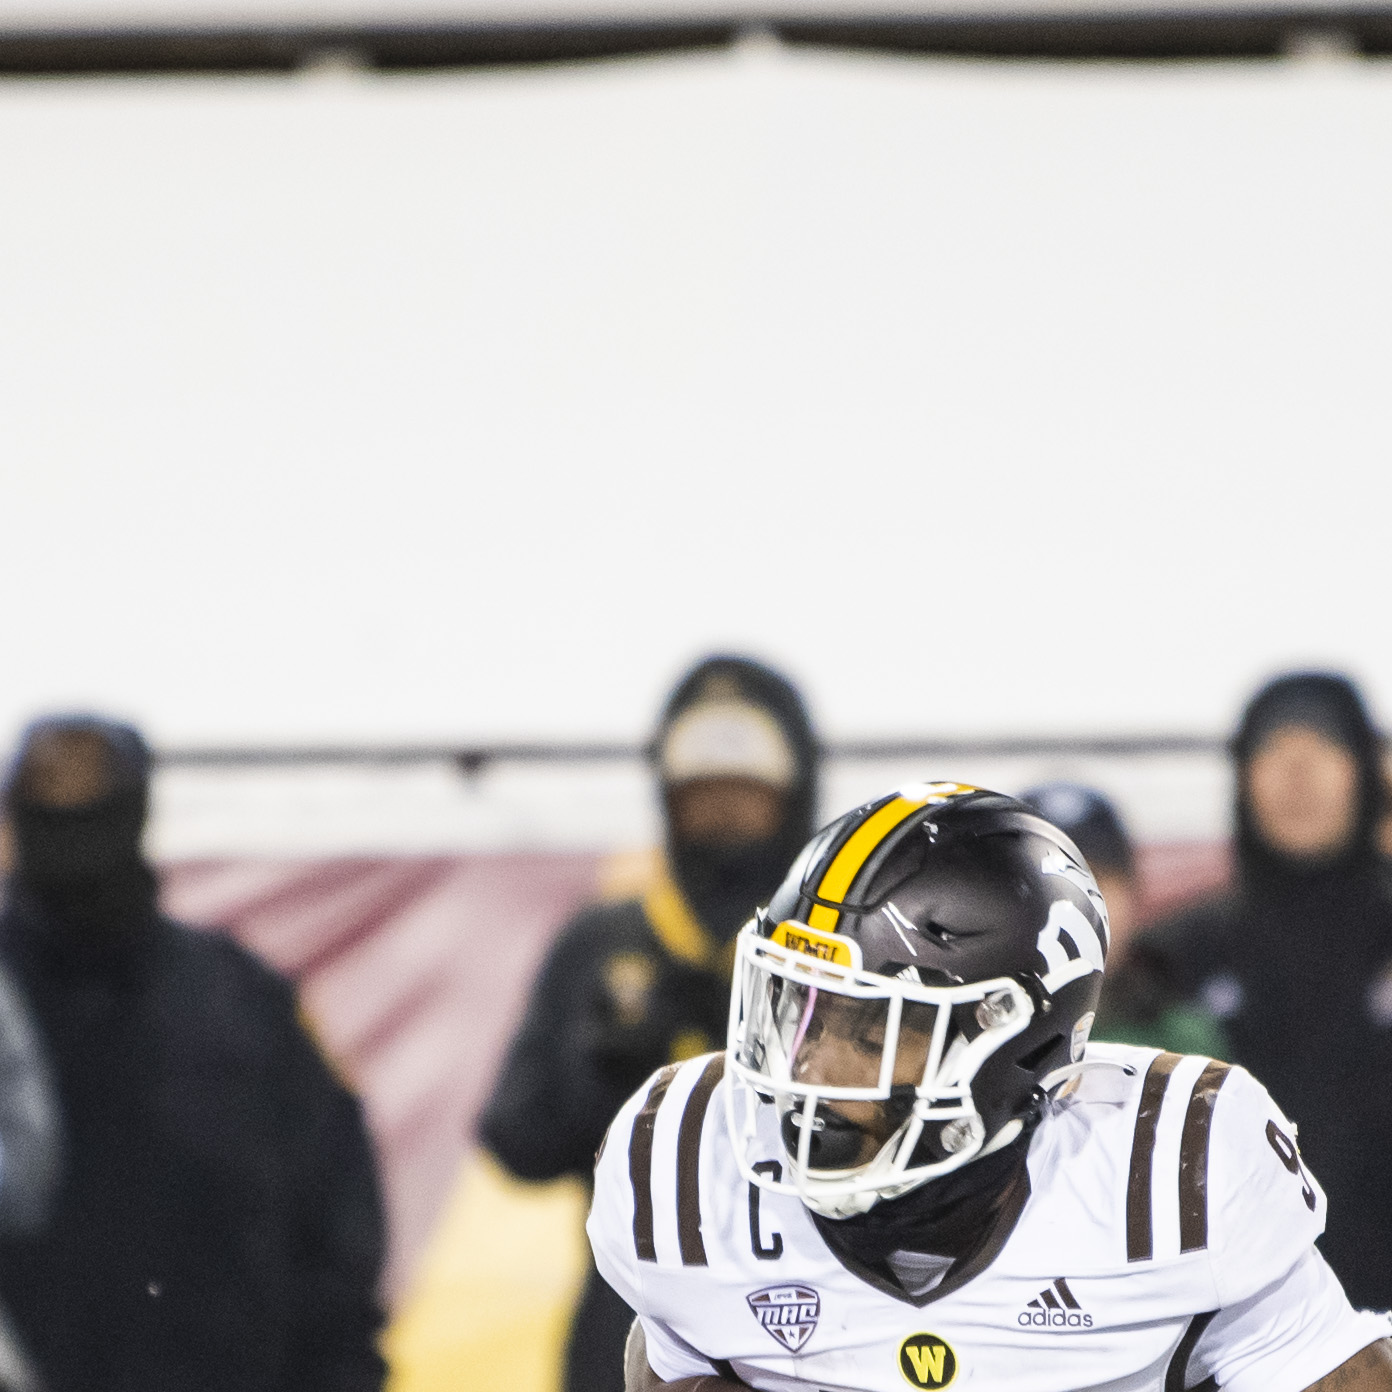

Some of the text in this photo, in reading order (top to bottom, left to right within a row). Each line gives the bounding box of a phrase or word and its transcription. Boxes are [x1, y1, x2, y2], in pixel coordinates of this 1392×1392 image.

[1265, 1118, 1316, 1213] 9
[748, 1159, 784, 1261] C
[755, 1304, 818, 1325] MAC
[1018, 1308, 1093, 1327] adidas
[905, 1345, 946, 1384] W
